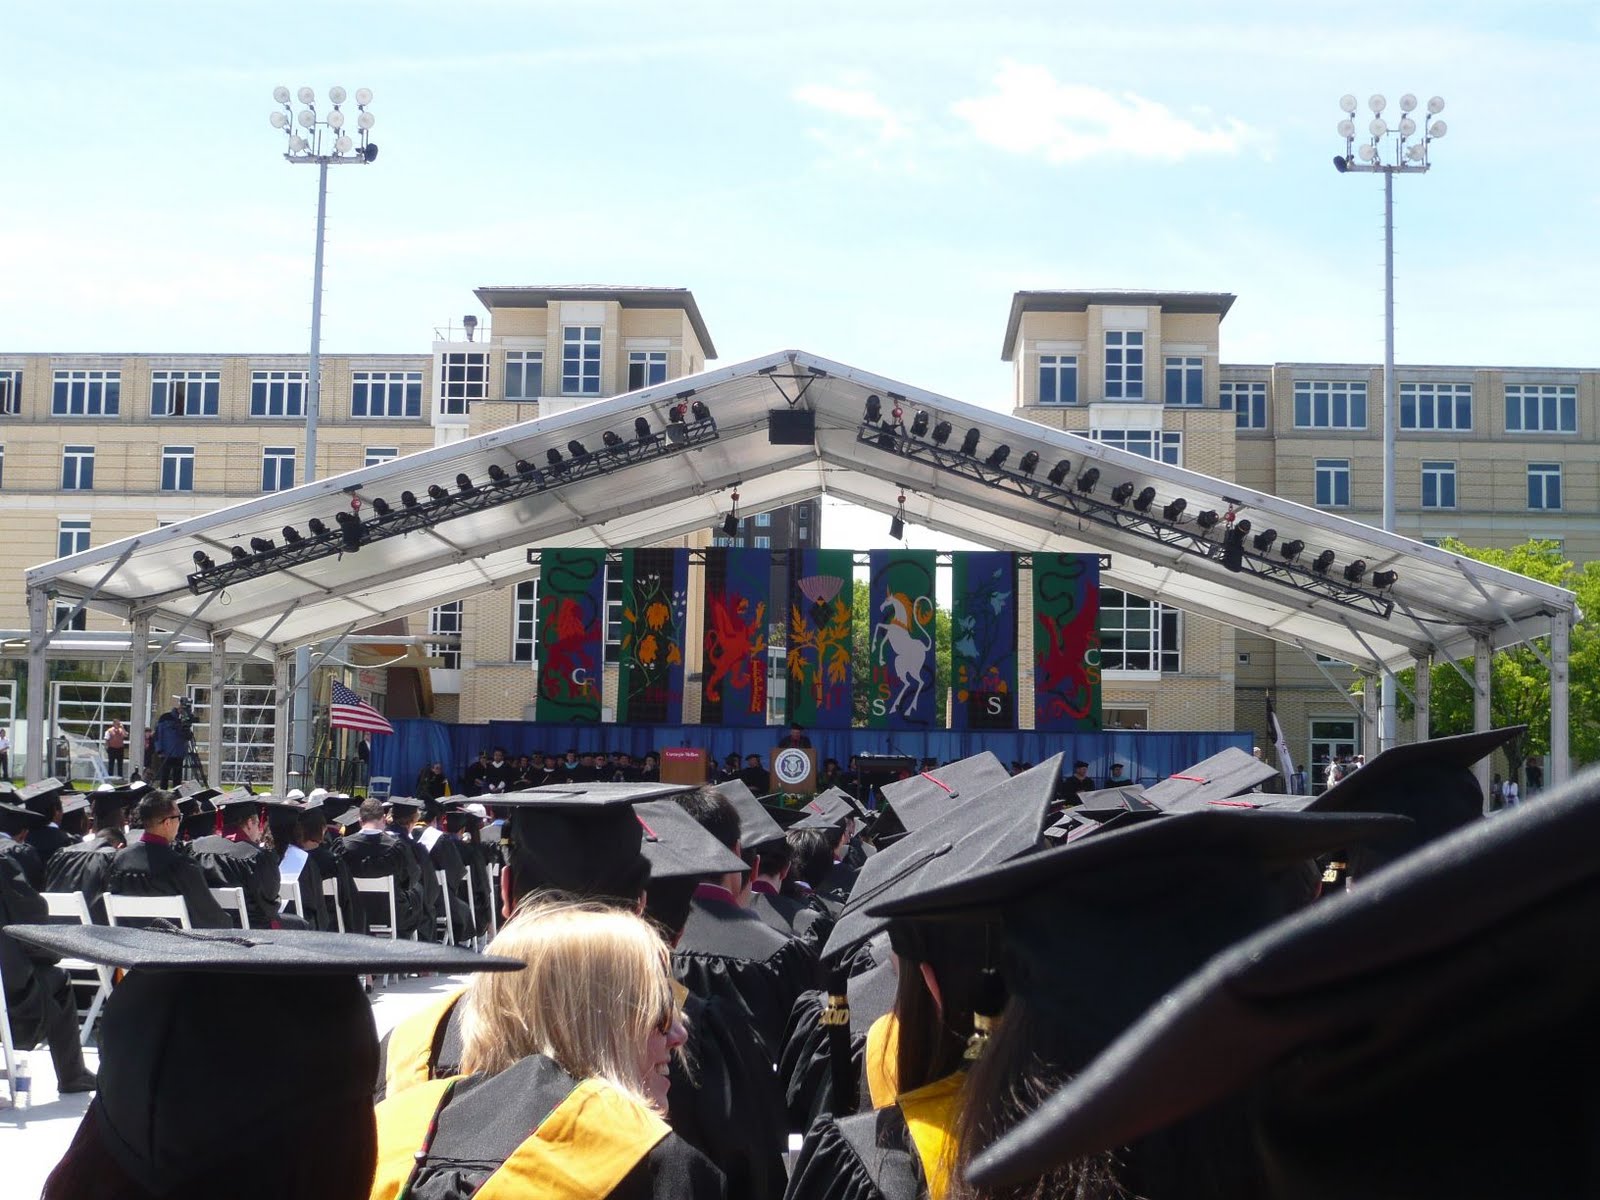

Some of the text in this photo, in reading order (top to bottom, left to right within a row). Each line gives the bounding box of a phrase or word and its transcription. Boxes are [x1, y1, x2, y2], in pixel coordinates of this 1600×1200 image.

[872, 699, 886, 716] S
[987, 697, 1002, 715] S
[819, 1008, 849, 1025] 2010
